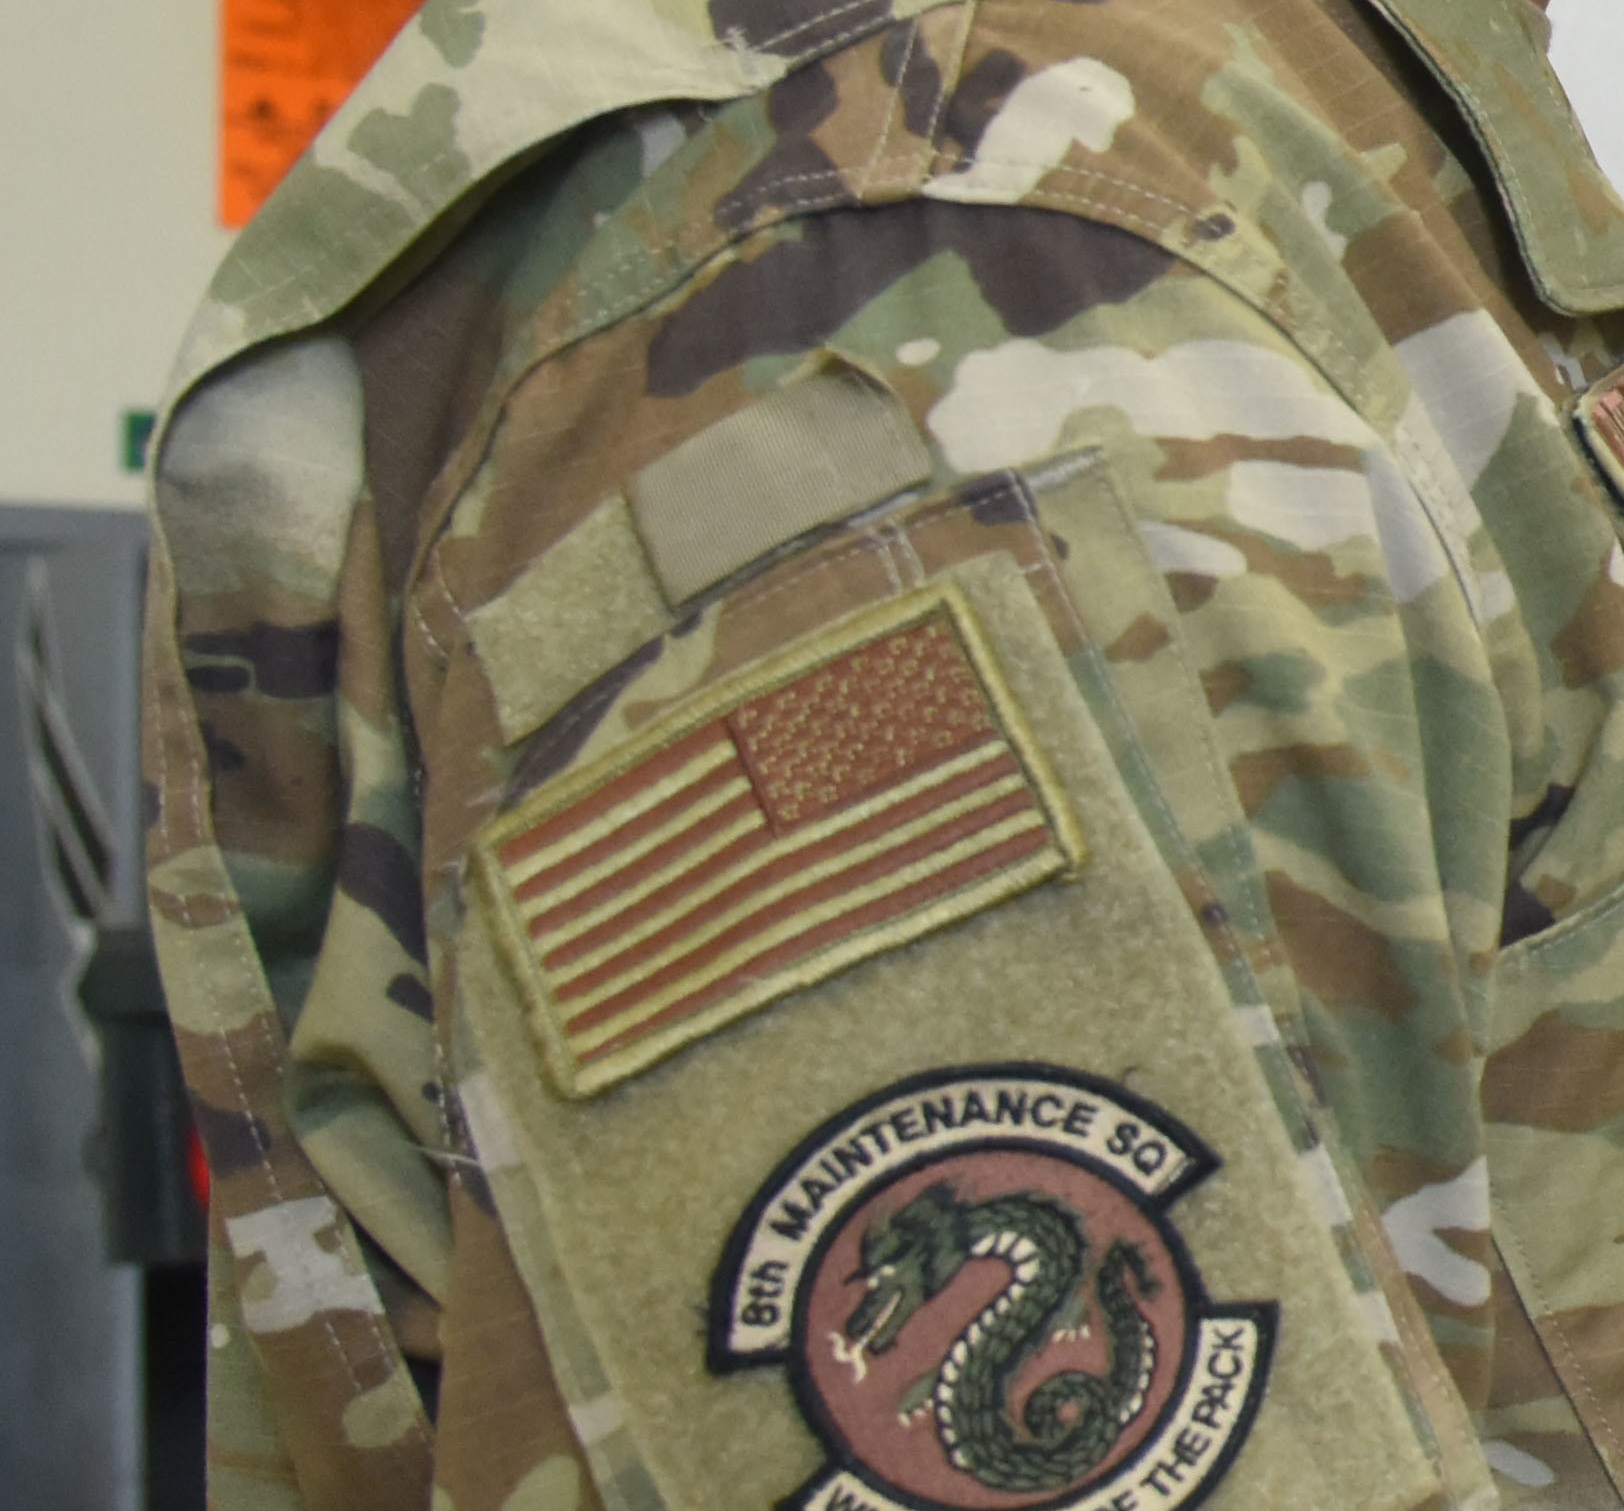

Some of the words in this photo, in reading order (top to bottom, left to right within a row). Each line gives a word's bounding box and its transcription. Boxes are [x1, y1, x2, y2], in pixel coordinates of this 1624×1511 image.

[740, 1260, 788, 1328] 8th
[769, 1089, 1098, 1236] MAINTENANCE
[1105, 1120, 1169, 1177] SQ
[1140, 1428, 1210, 1496] THE
[1193, 1324, 1246, 1427] PACK
